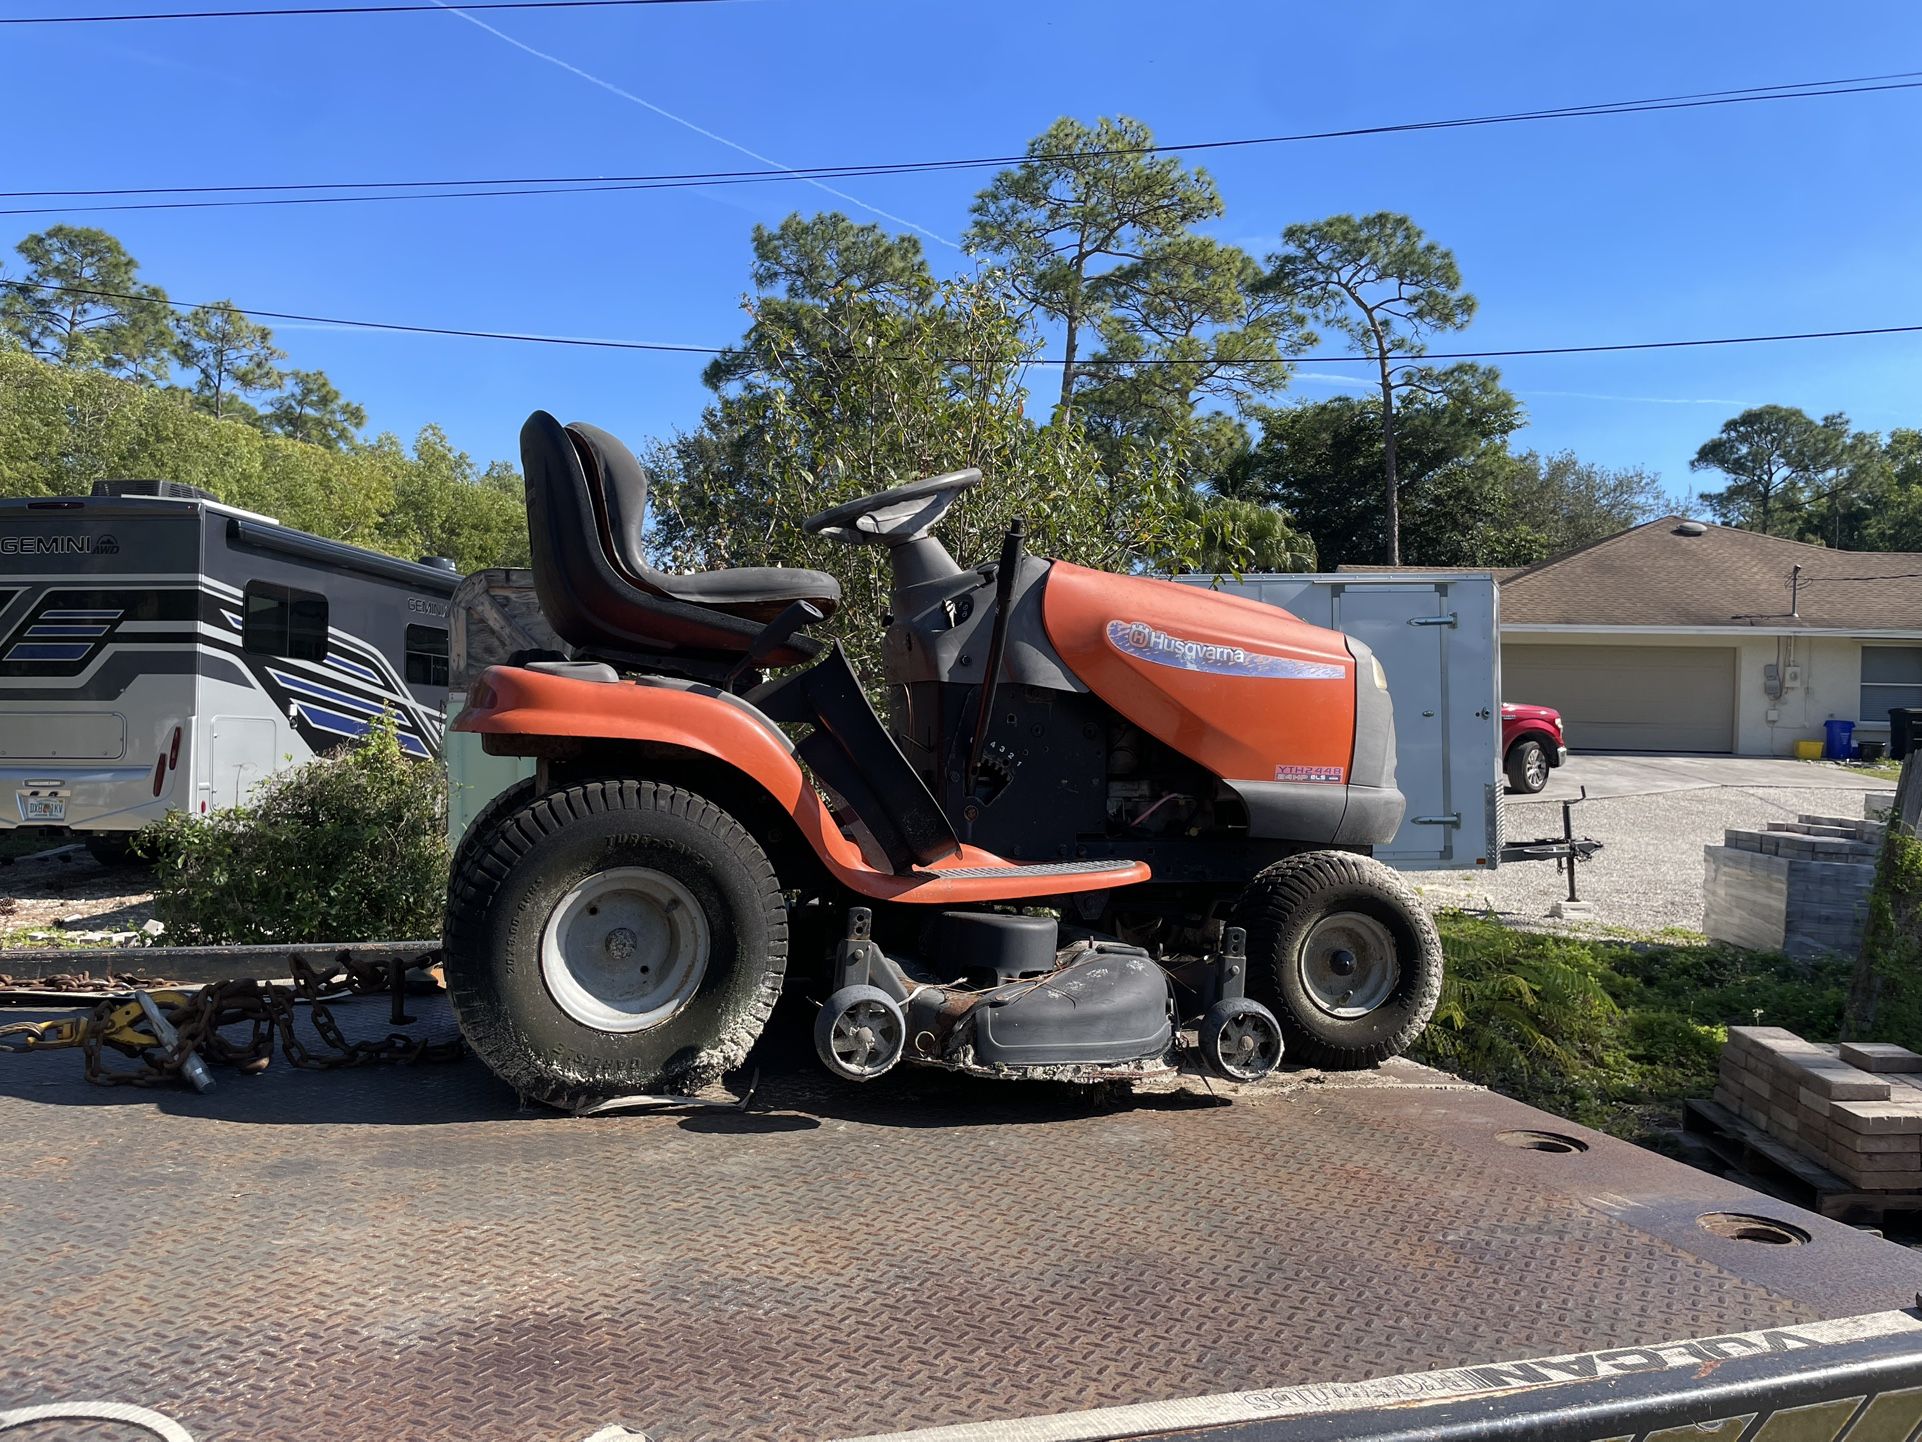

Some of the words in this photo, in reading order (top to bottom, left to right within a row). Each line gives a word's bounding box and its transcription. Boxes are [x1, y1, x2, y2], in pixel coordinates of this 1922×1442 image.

[0, 536, 91, 554] GEMINI
[92, 545, 119, 554] AWD
[1150, 631, 1245, 663] Husqvarna
[1279, 766, 1341, 775] YTH2448
[1476, 1329, 1824, 1385] VULCAN
